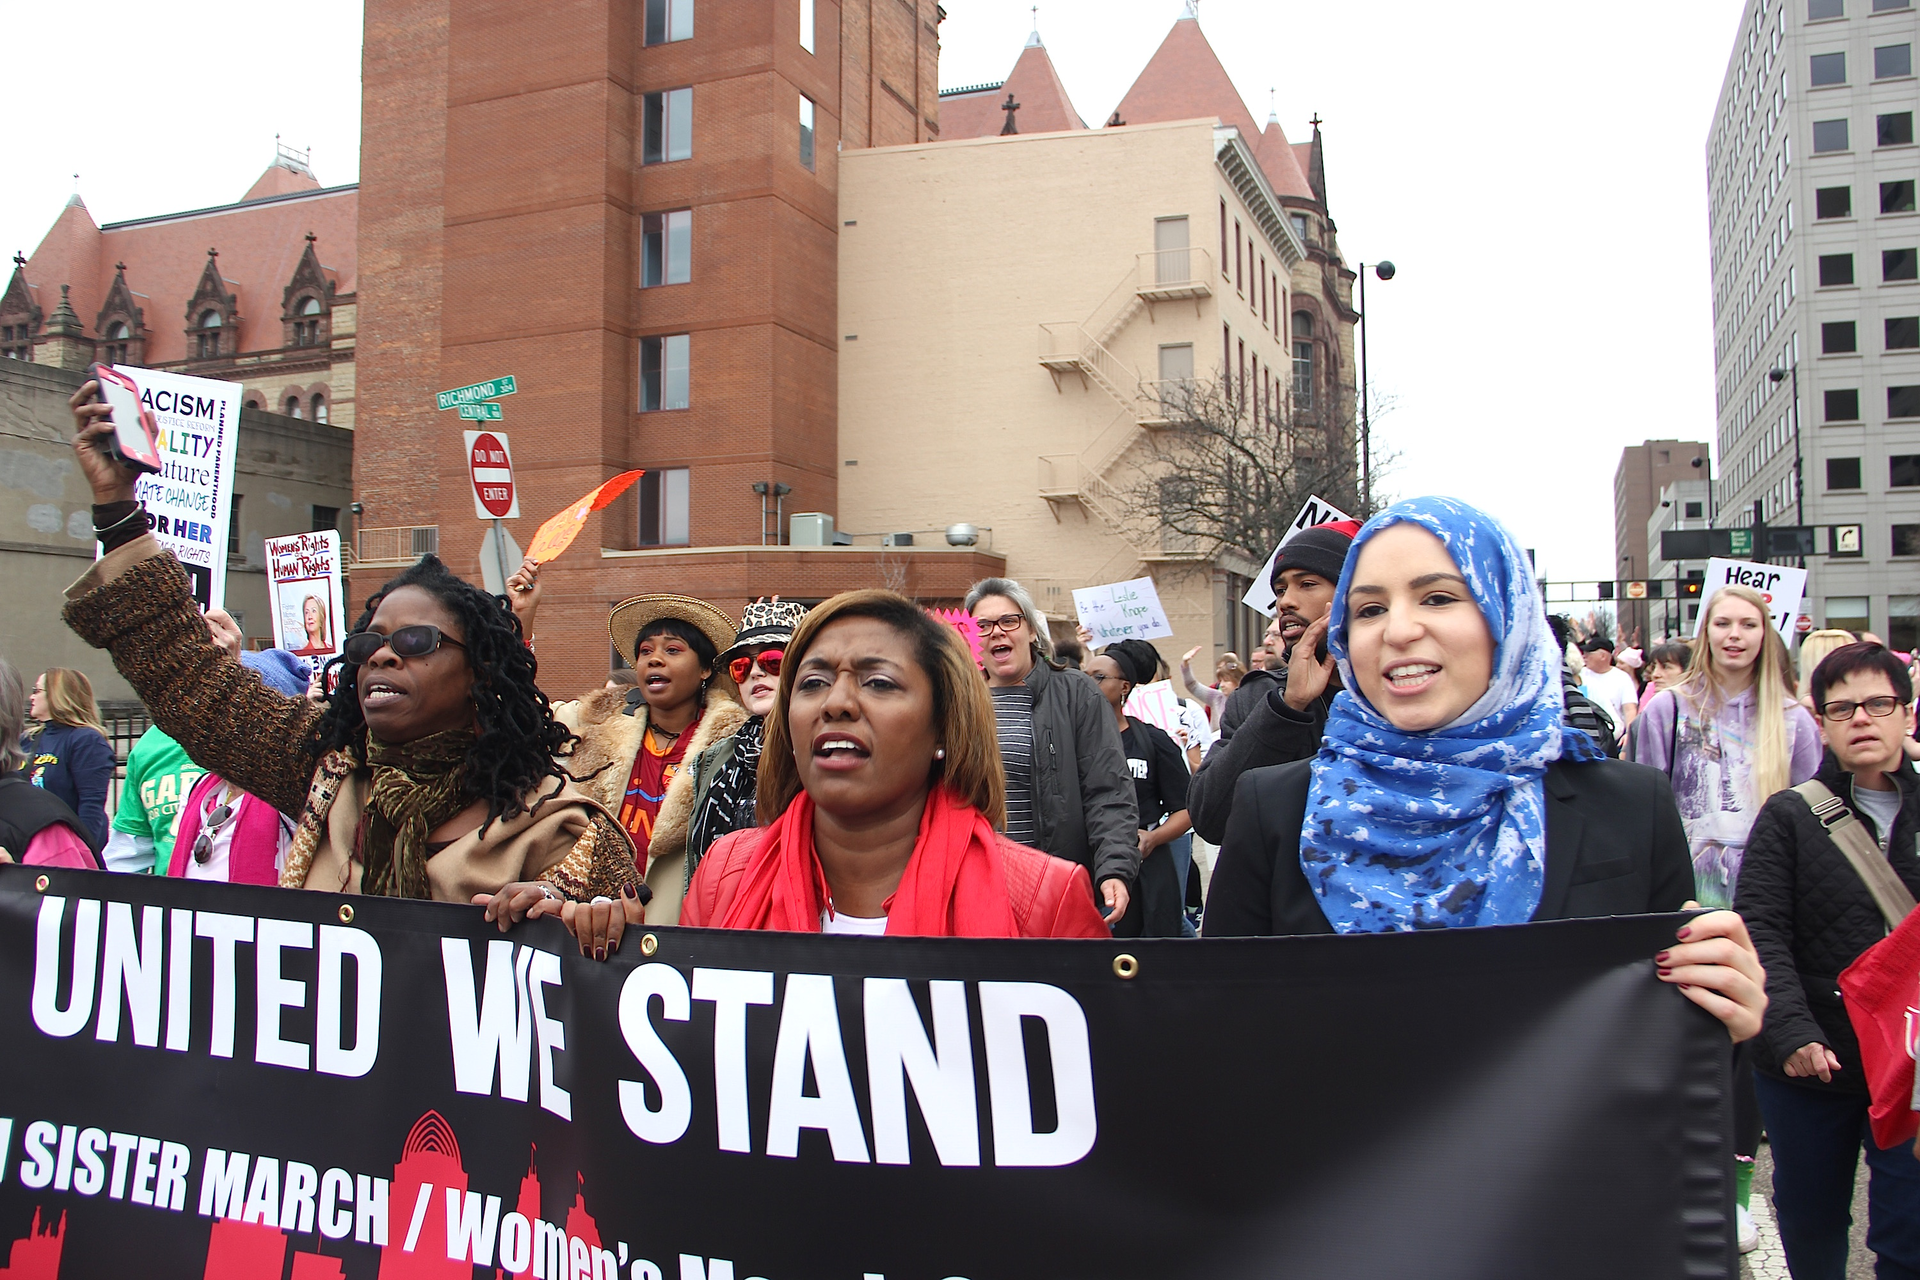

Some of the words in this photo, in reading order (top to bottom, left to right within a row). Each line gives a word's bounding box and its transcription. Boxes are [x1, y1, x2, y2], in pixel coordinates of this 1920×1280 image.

[141, 388, 215, 420] ACISM
[439, 383, 496, 407] RICHMOND
[156, 414, 184, 428] USTICE
[460, 404, 491, 418] CENTRAL
[216, 400, 226, 448] PLANNED
[156, 428, 214, 458] ALITY
[474, 449, 487, 462] DO
[489, 450, 505, 463] NOT
[158, 459, 210, 486] uture
[210, 450, 222, 519] PARENTHOOD
[134, 480, 165, 502] MATE
[165, 488, 210, 512] CHANGE
[483, 487, 509, 500] ENTER
[147, 512, 170, 535] OR
[173, 518, 213, 544] HER
[177, 544, 211, 564] RIGHTS
[1725, 566, 1781, 591] Hear
[1111, 586, 1138, 603] Leslie
[1121, 603, 1148, 618] Knope
[1137, 624, 1149, 638] you
[1126, 757, 1148, 779] TTER
[31, 895, 382, 1077] UNITED
[441, 937, 572, 1122] WE
[618, 962, 1097, 1166] STAND
[20, 1121, 191, 1211] SISTER
[198, 1148, 389, 1246] MARCH
[402, 1183, 423, 1252] /
